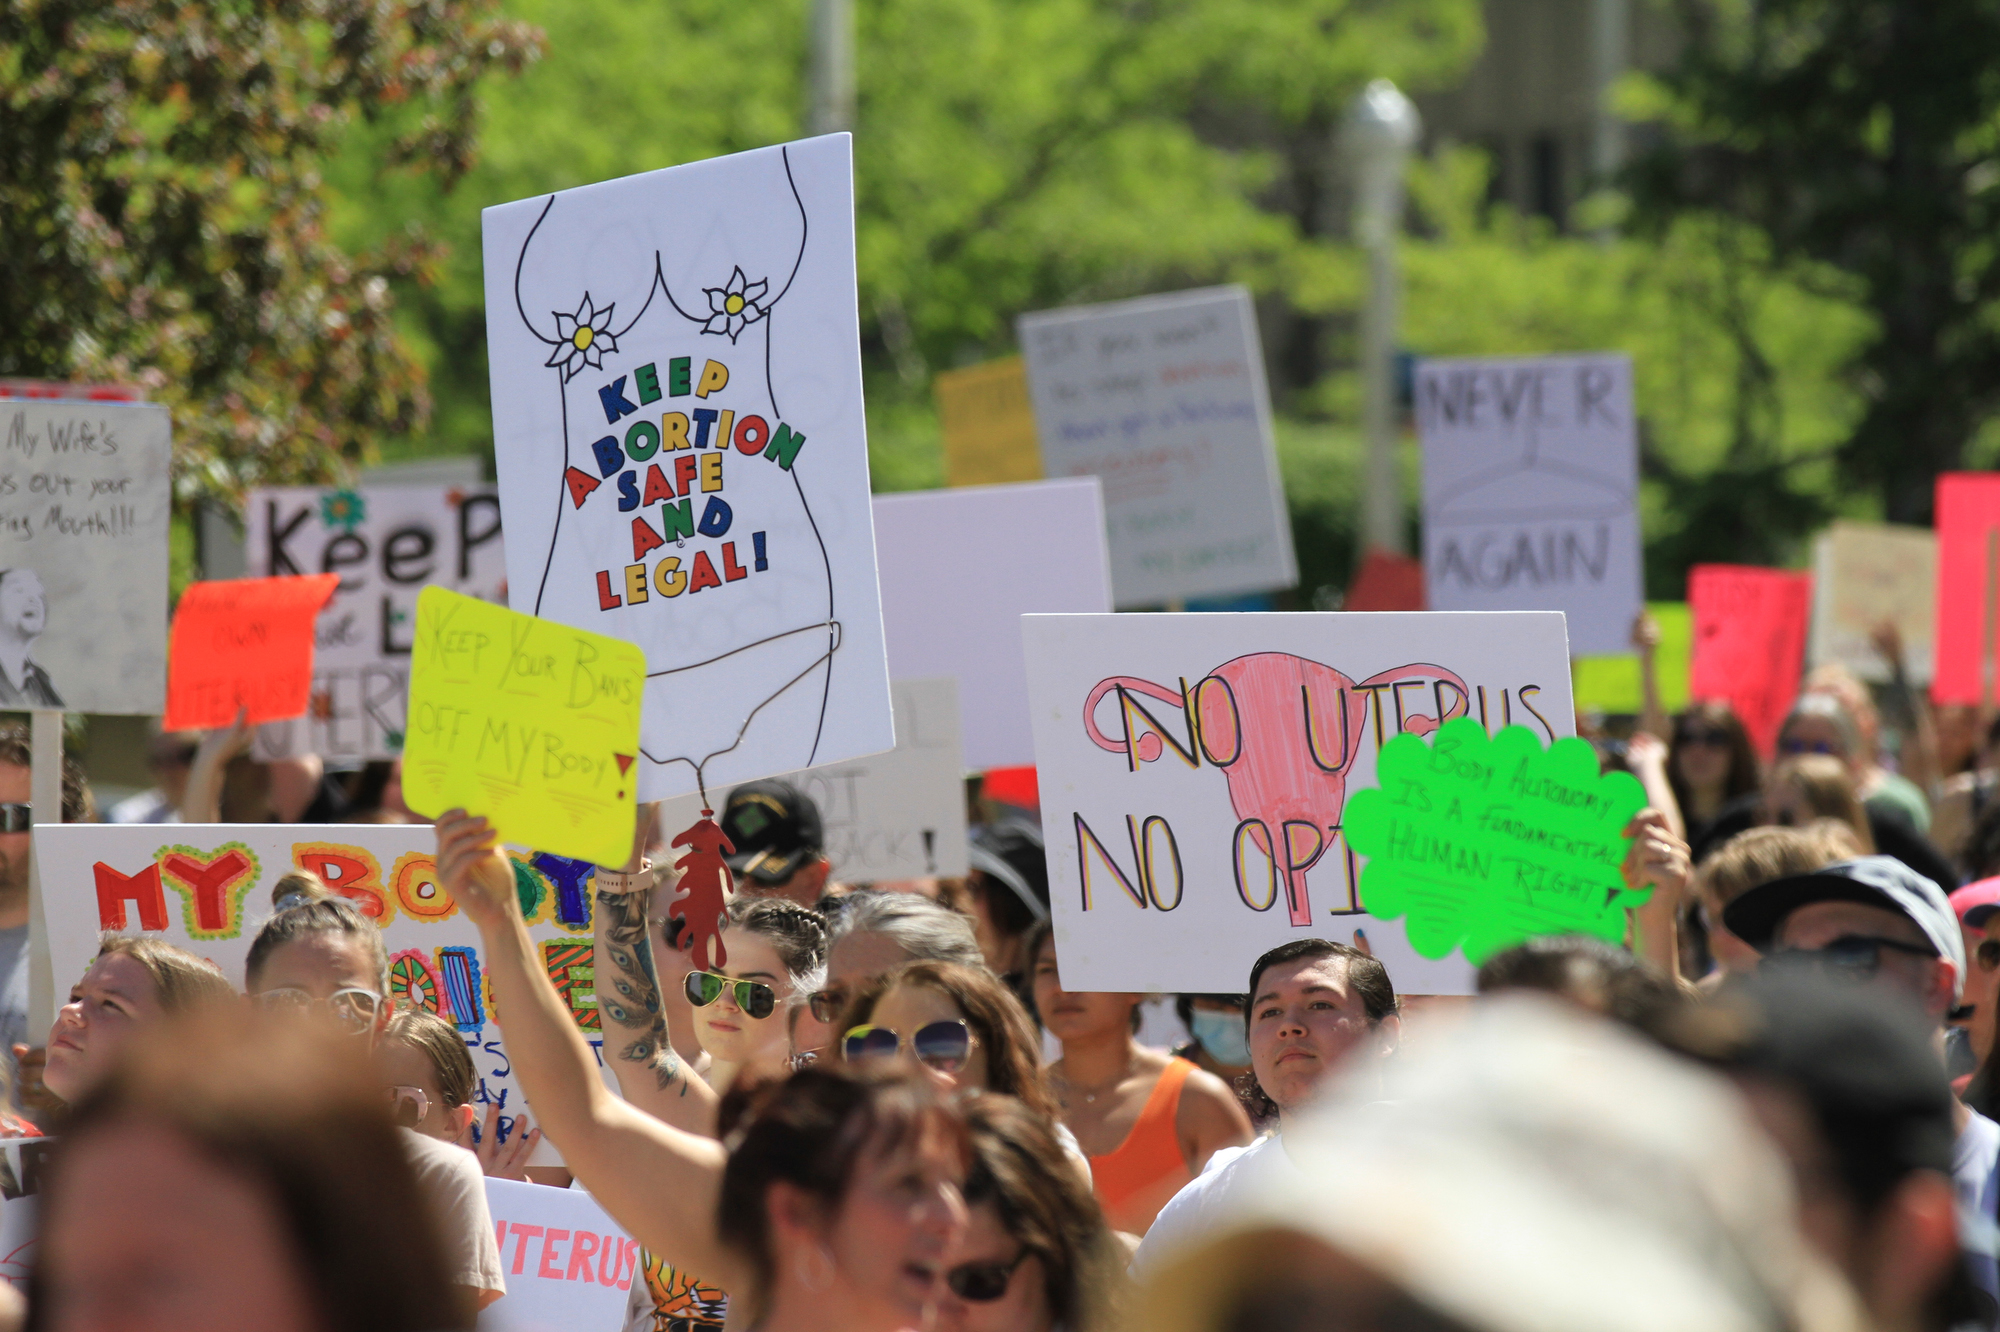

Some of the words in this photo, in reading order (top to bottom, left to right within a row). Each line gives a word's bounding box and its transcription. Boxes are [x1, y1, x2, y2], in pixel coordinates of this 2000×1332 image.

[598, 356, 730, 425] KEEP
[1427, 366, 1622, 430] NEVER
[6, 411, 39, 459] My
[47, 418, 118, 456] Wife's
[565, 408, 806, 510] ABORTION
[617, 452, 723, 512] SAFE
[631, 495, 733, 562] AND
[1436, 523, 1611, 592] AGAIN
[596, 531, 769, 611] LEGAL!
[416, 701, 471, 753] OFF
[476, 716, 539, 787] MY
[1114, 675, 1242, 772] NO
[790, 766, 871, 824] OT
[1391, 776, 1433, 813] IS
[1446, 796, 1463, 824] A
[1073, 812, 1184, 912] NO
[1387, 817, 1493, 880] HUMAN
[93, 846, 254, 936] MY
